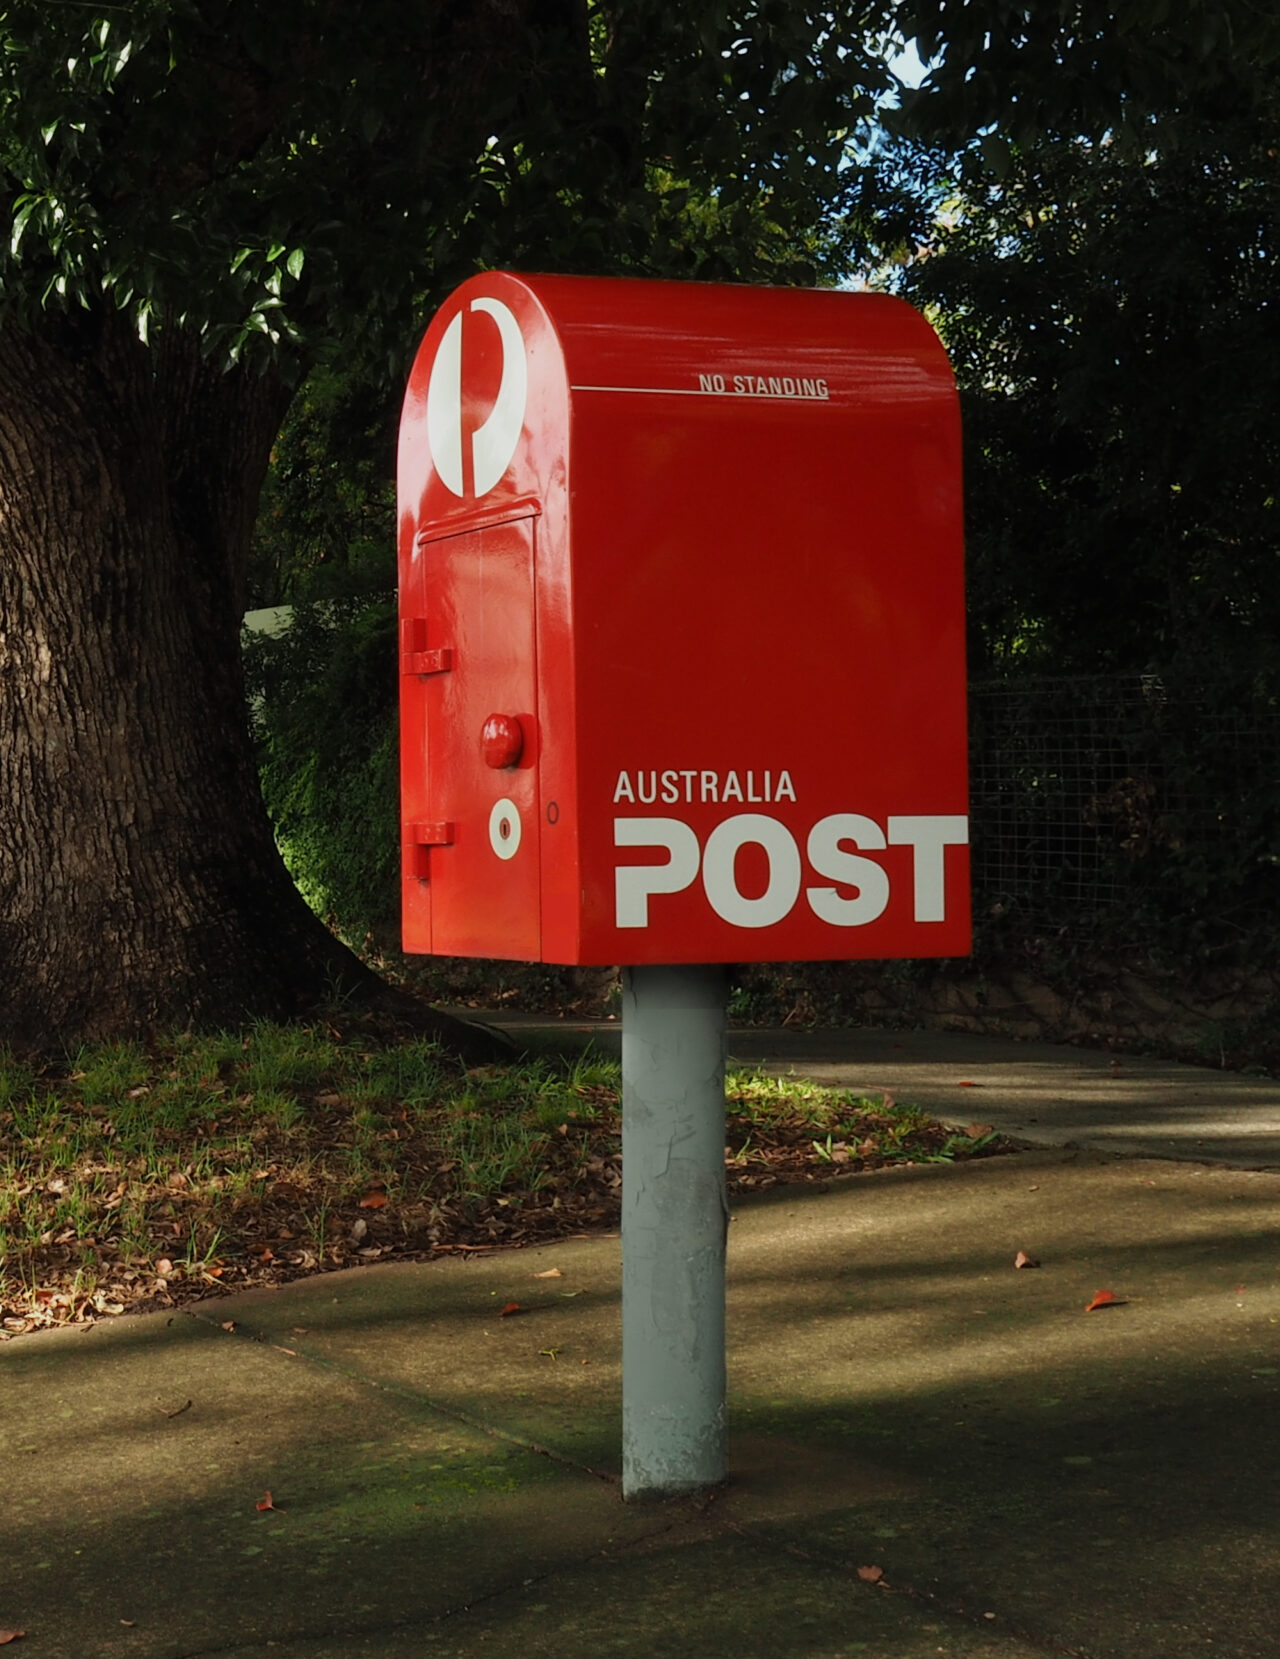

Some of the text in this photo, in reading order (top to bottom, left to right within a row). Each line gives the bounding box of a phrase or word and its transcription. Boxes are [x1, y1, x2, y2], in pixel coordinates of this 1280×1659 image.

[698, 373, 829, 397] NO STANDING
[613, 770, 797, 804] AUSTRALIA
[614, 813, 969, 928] POST
